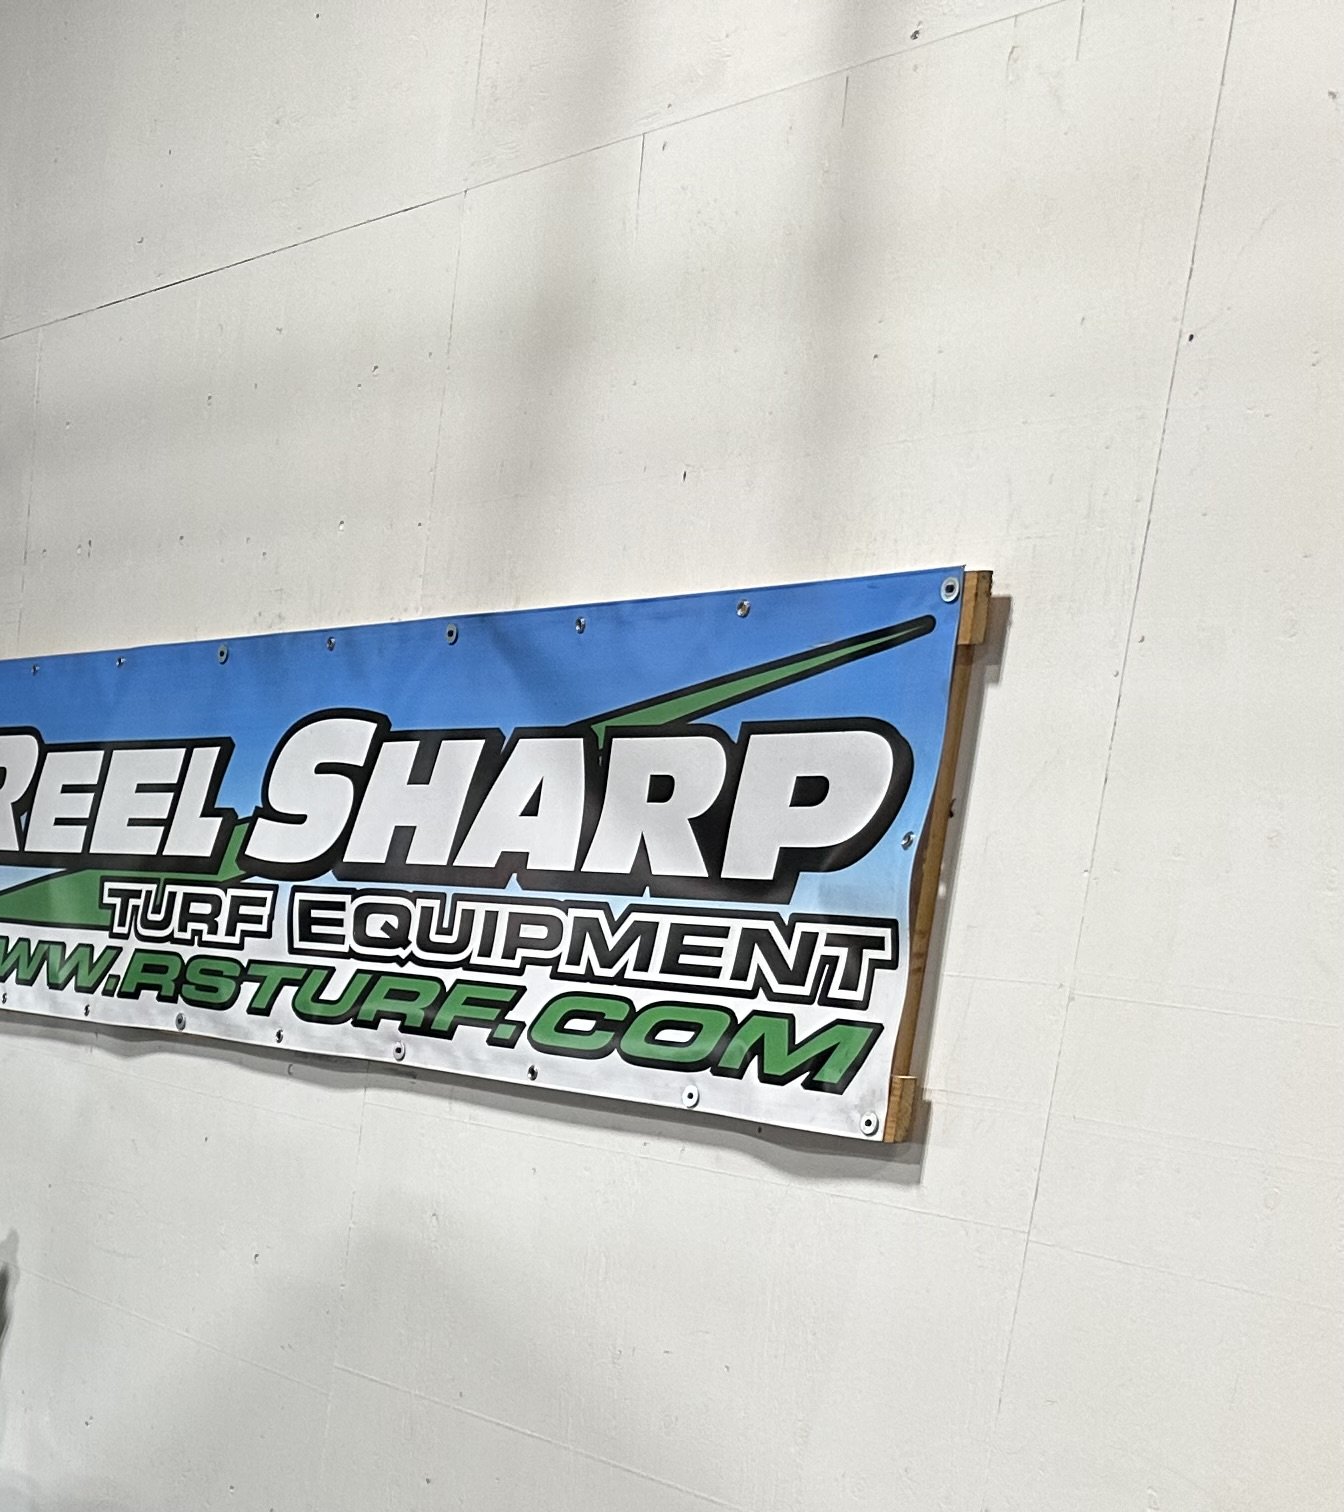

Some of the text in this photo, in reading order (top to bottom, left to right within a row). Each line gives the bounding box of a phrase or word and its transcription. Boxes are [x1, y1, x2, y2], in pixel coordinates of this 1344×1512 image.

[242, 711, 902, 890] SHARP
[103, 882, 898, 1004] TURF EQUIPMENT
